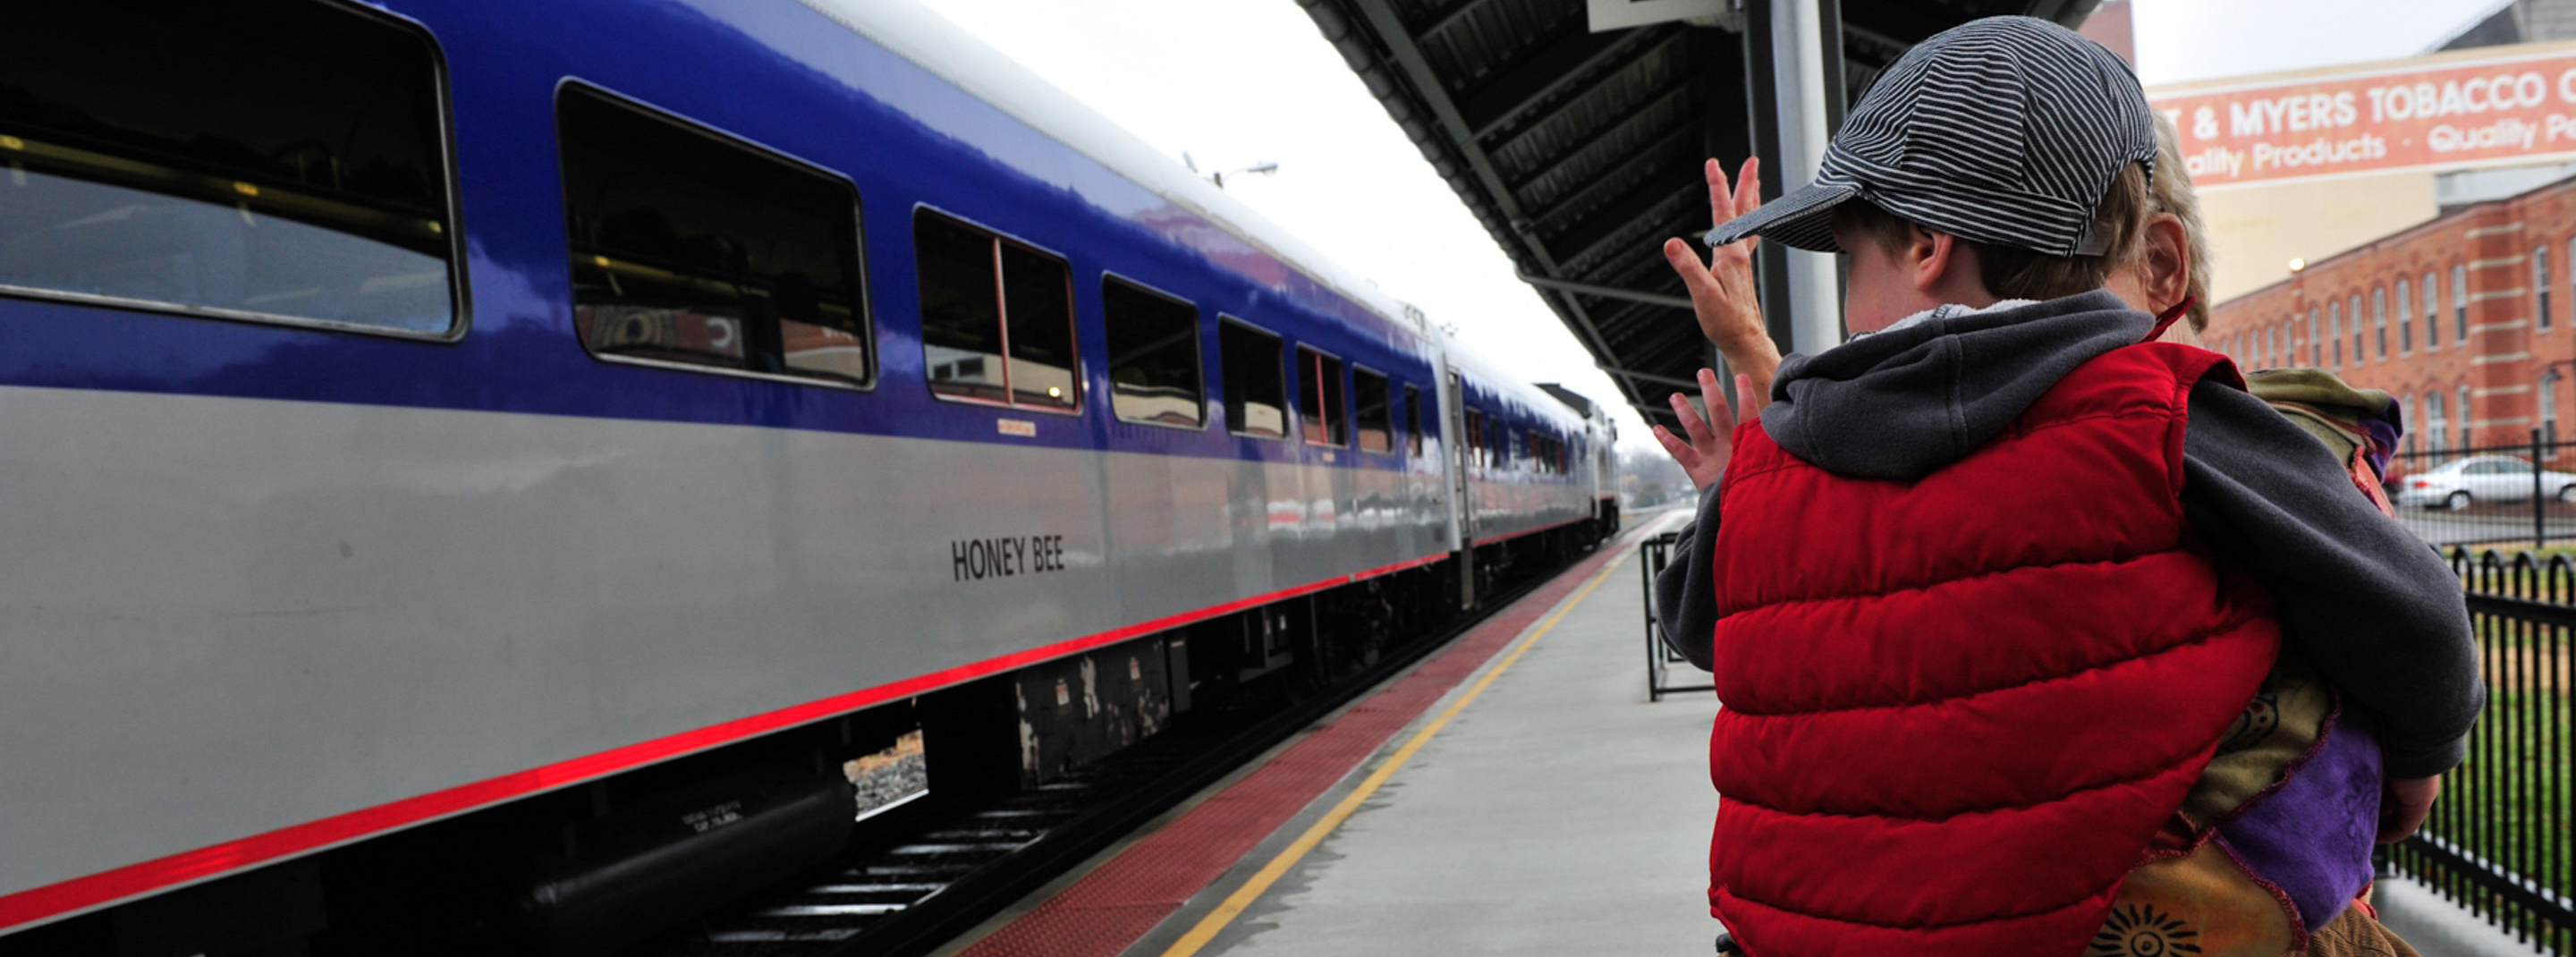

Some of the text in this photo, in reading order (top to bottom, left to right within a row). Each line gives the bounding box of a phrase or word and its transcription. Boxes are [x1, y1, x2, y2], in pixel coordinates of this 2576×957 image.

[2193, 106, 2219, 140] &
[2229, 91, 2357, 137] MYERS
[2367, 72, 2547, 123] TOBACCO
[2253, 132, 2386, 170] Products
[2427, 117, 2538, 152] Quality
[952, 536, 1064, 581] HONEY BEE
